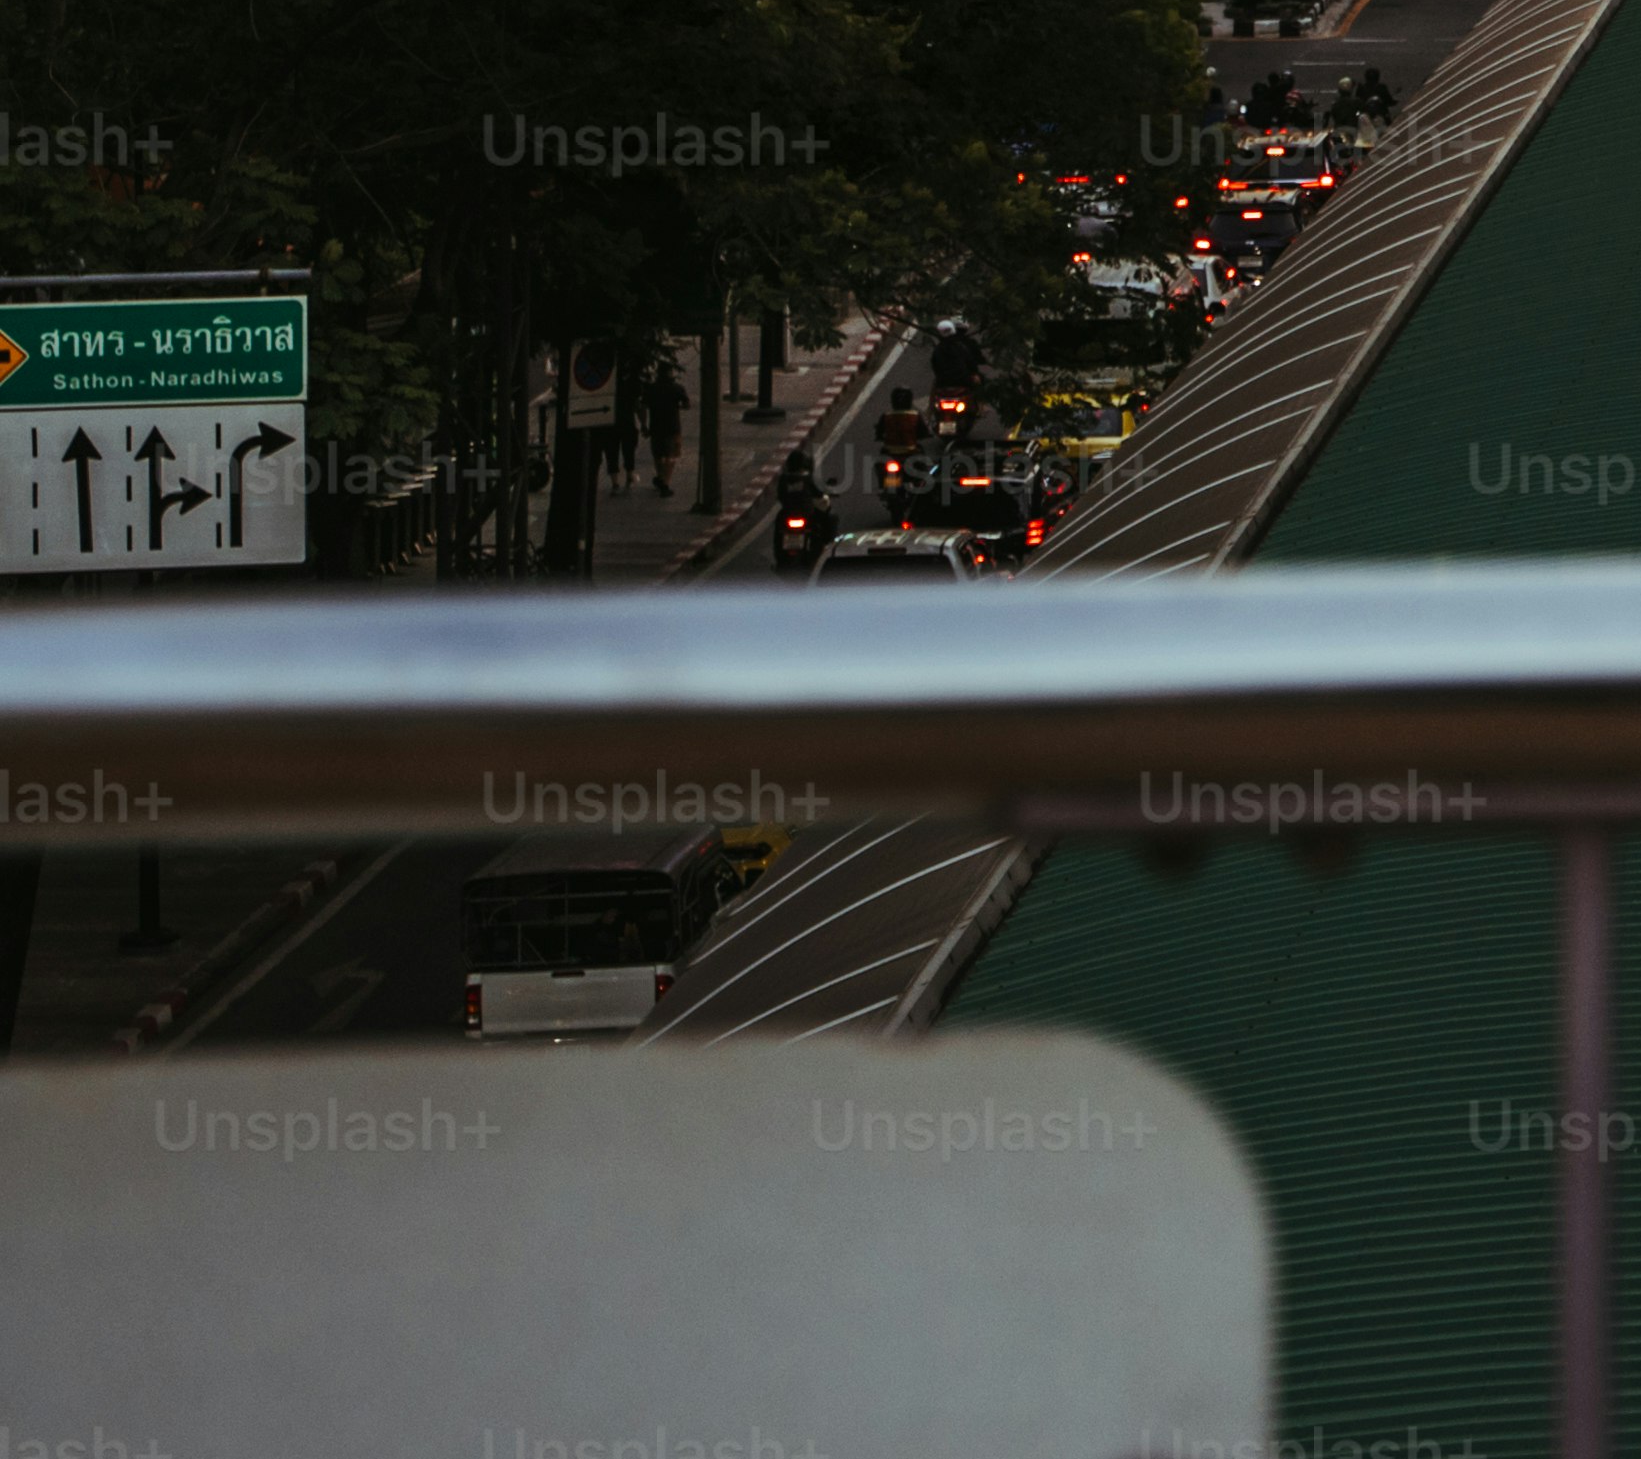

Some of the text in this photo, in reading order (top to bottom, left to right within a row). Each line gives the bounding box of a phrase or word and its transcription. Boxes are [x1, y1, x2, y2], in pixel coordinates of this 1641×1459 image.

[40, 328, 125, 358] สาทร
[152, 315, 294, 355] นราธิวาส
[53, 373, 133, 390] Sathon
[151, 368, 283, 387] Naradhiwas
